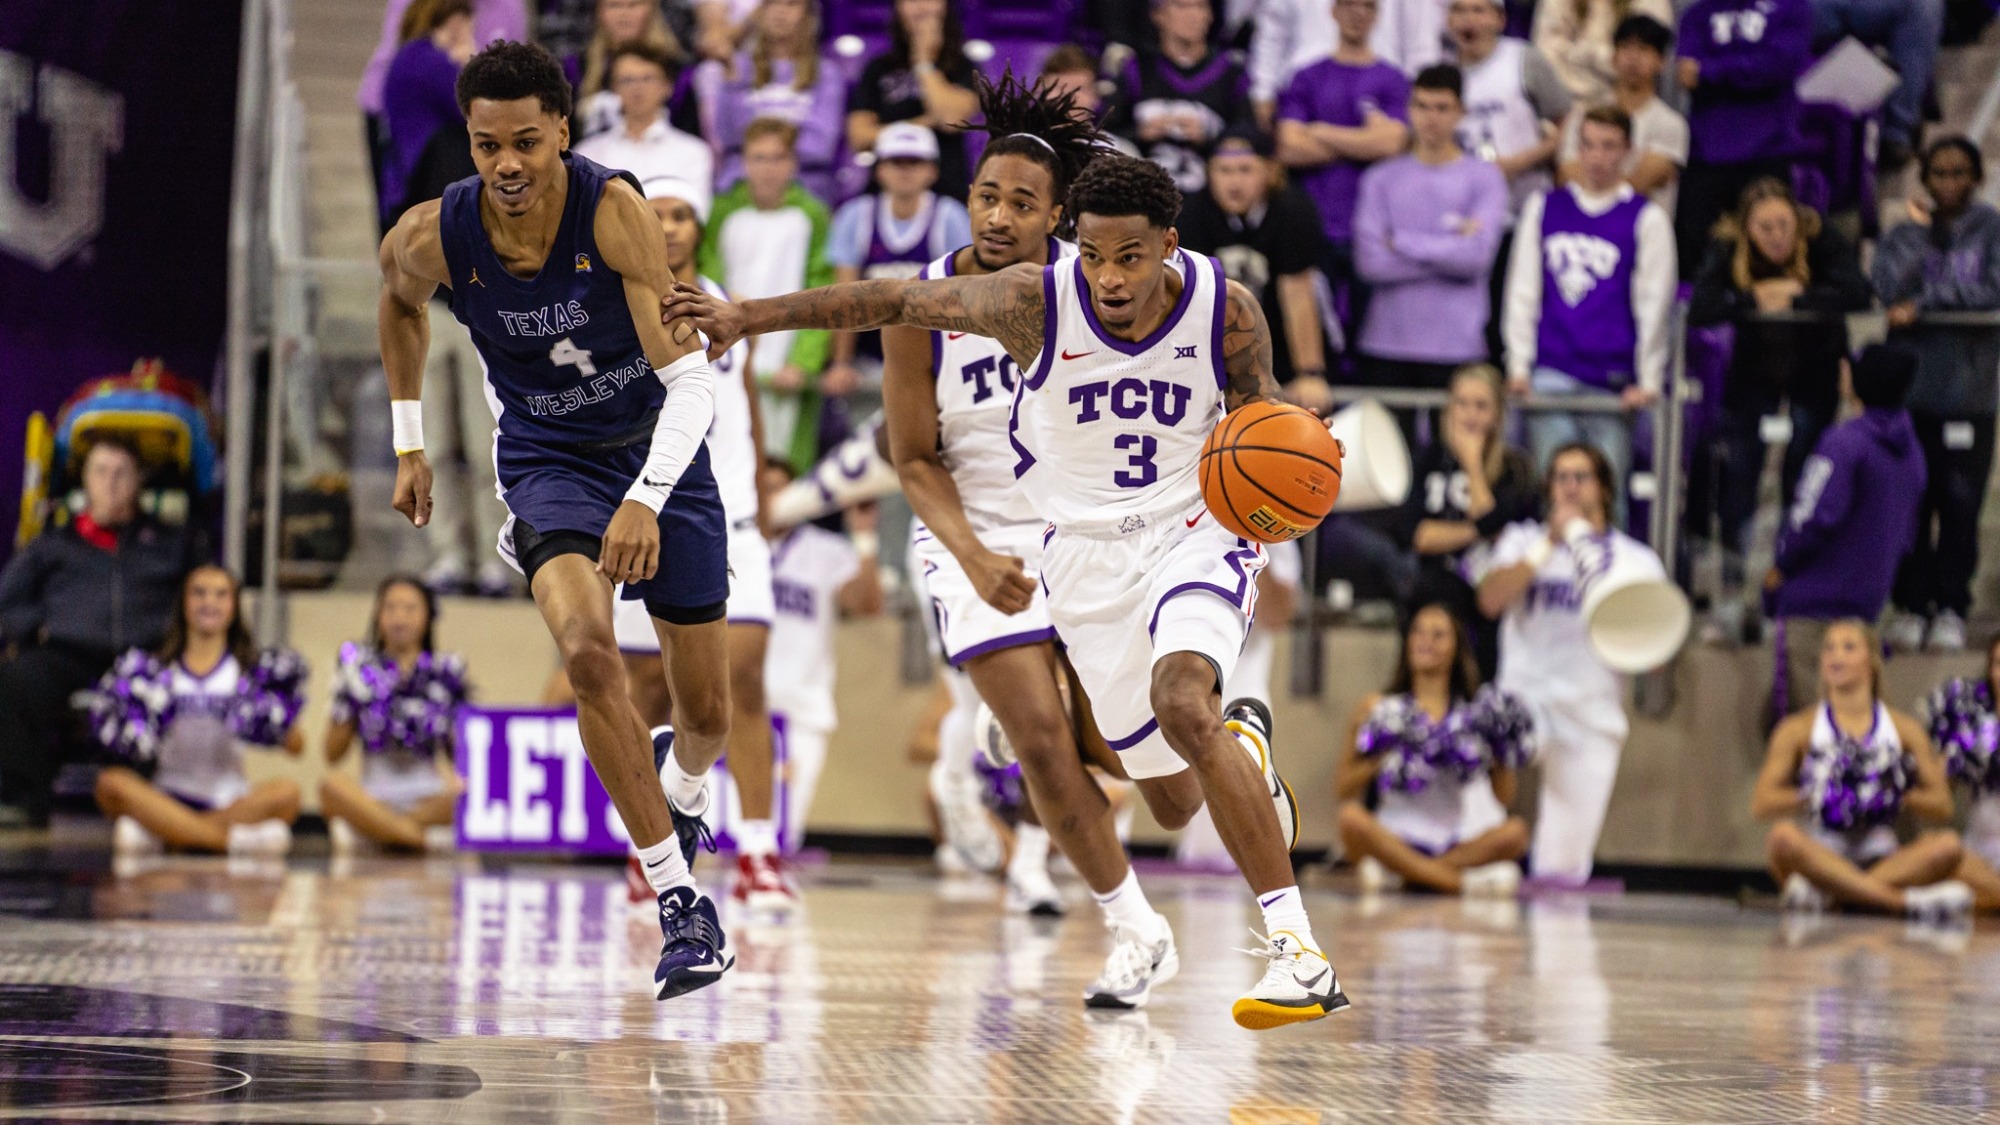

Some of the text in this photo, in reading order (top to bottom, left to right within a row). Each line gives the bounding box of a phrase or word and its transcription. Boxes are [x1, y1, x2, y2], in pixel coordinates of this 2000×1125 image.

[497, 299, 590, 337] TEXAS
[549, 336, 598, 378] 4
[1173, 345, 1197, 360] XII
[524, 354, 653, 416] WESLEYAN
[961, 354, 1018, 404] TC
[1068, 377, 1192, 427] TCU
[1114, 433, 1158, 488] 3
[464, 714, 632, 843] LET
